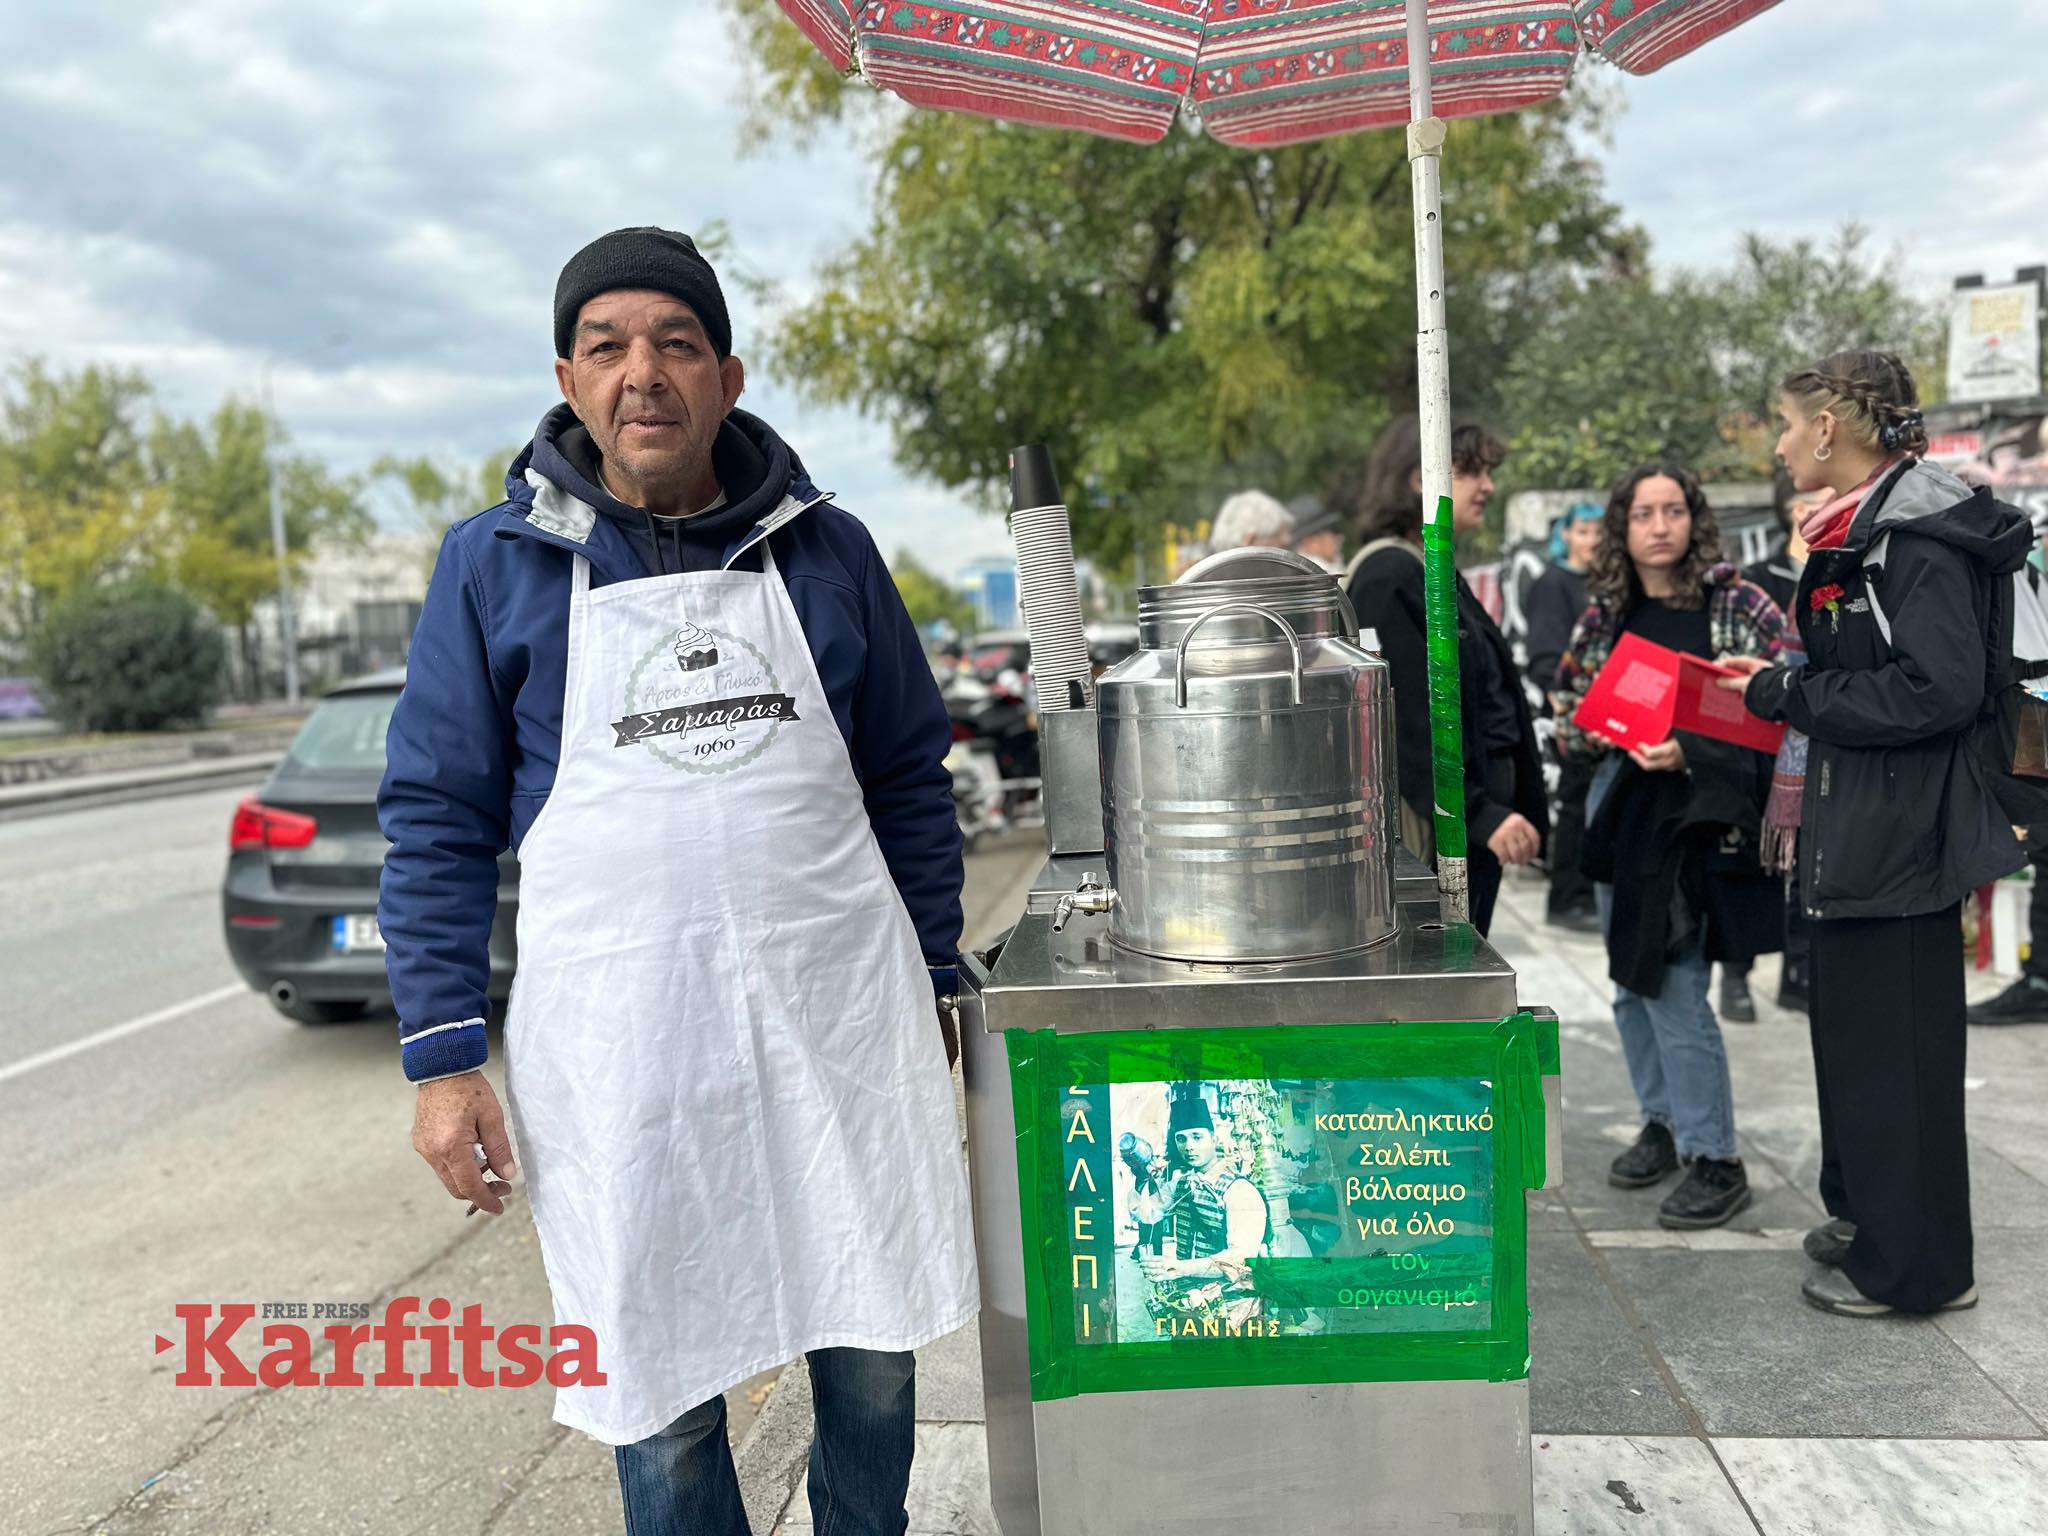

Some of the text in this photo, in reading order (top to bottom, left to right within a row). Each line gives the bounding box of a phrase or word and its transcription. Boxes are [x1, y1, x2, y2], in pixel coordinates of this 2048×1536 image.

[695, 675, 709, 696] &
[634, 696, 782, 740] Σαμαράς
[694, 735, 736, 761] 1960
[1315, 1107, 1494, 1137] καταπληκτικό
[1359, 1142, 1451, 1167] Σαλέπι
[1346, 1176, 1466, 1206] βάλσαμο
[1356, 1211, 1455, 1240] για όλο
[1387, 1253, 1431, 1271] τον
[1338, 1283, 1479, 1312] οργανισμό
[1155, 1317, 1281, 1338] ΓΙΑΝΝΗΣ
